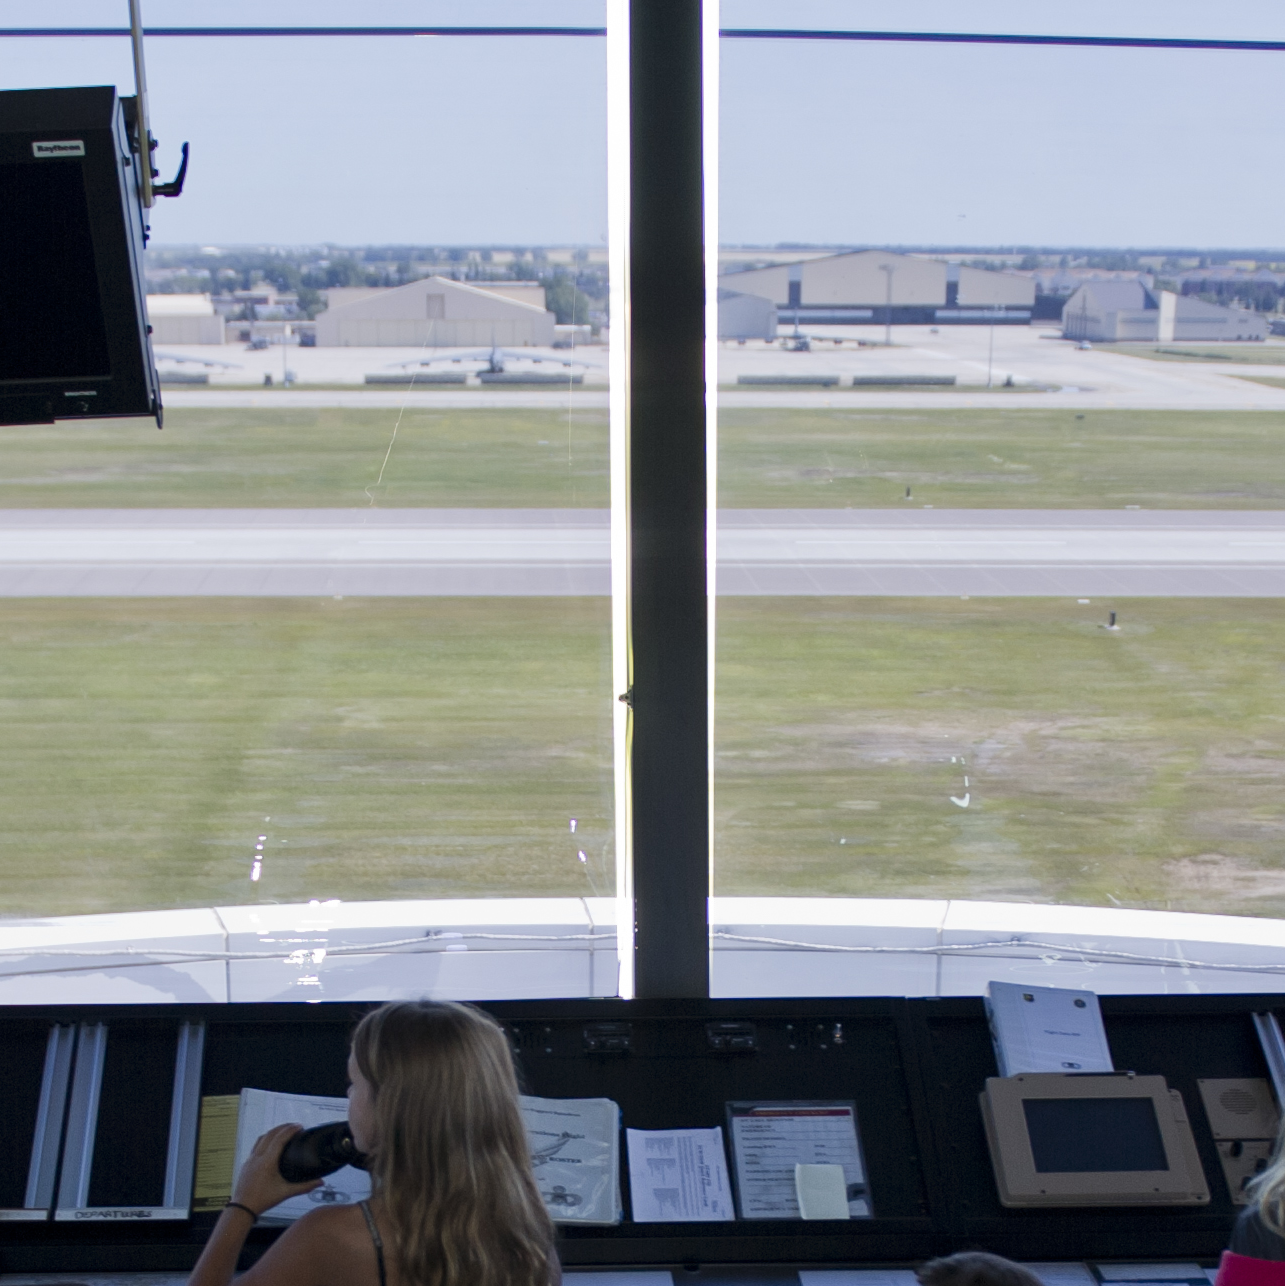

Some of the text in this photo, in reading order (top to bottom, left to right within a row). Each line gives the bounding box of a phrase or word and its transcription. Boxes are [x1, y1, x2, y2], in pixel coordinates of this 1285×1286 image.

[36, 144, 82, 155] Raytheon
[548, 1156, 583, 1164] ROSTER
[74, 1210, 152, 1220] DEPARTURES
